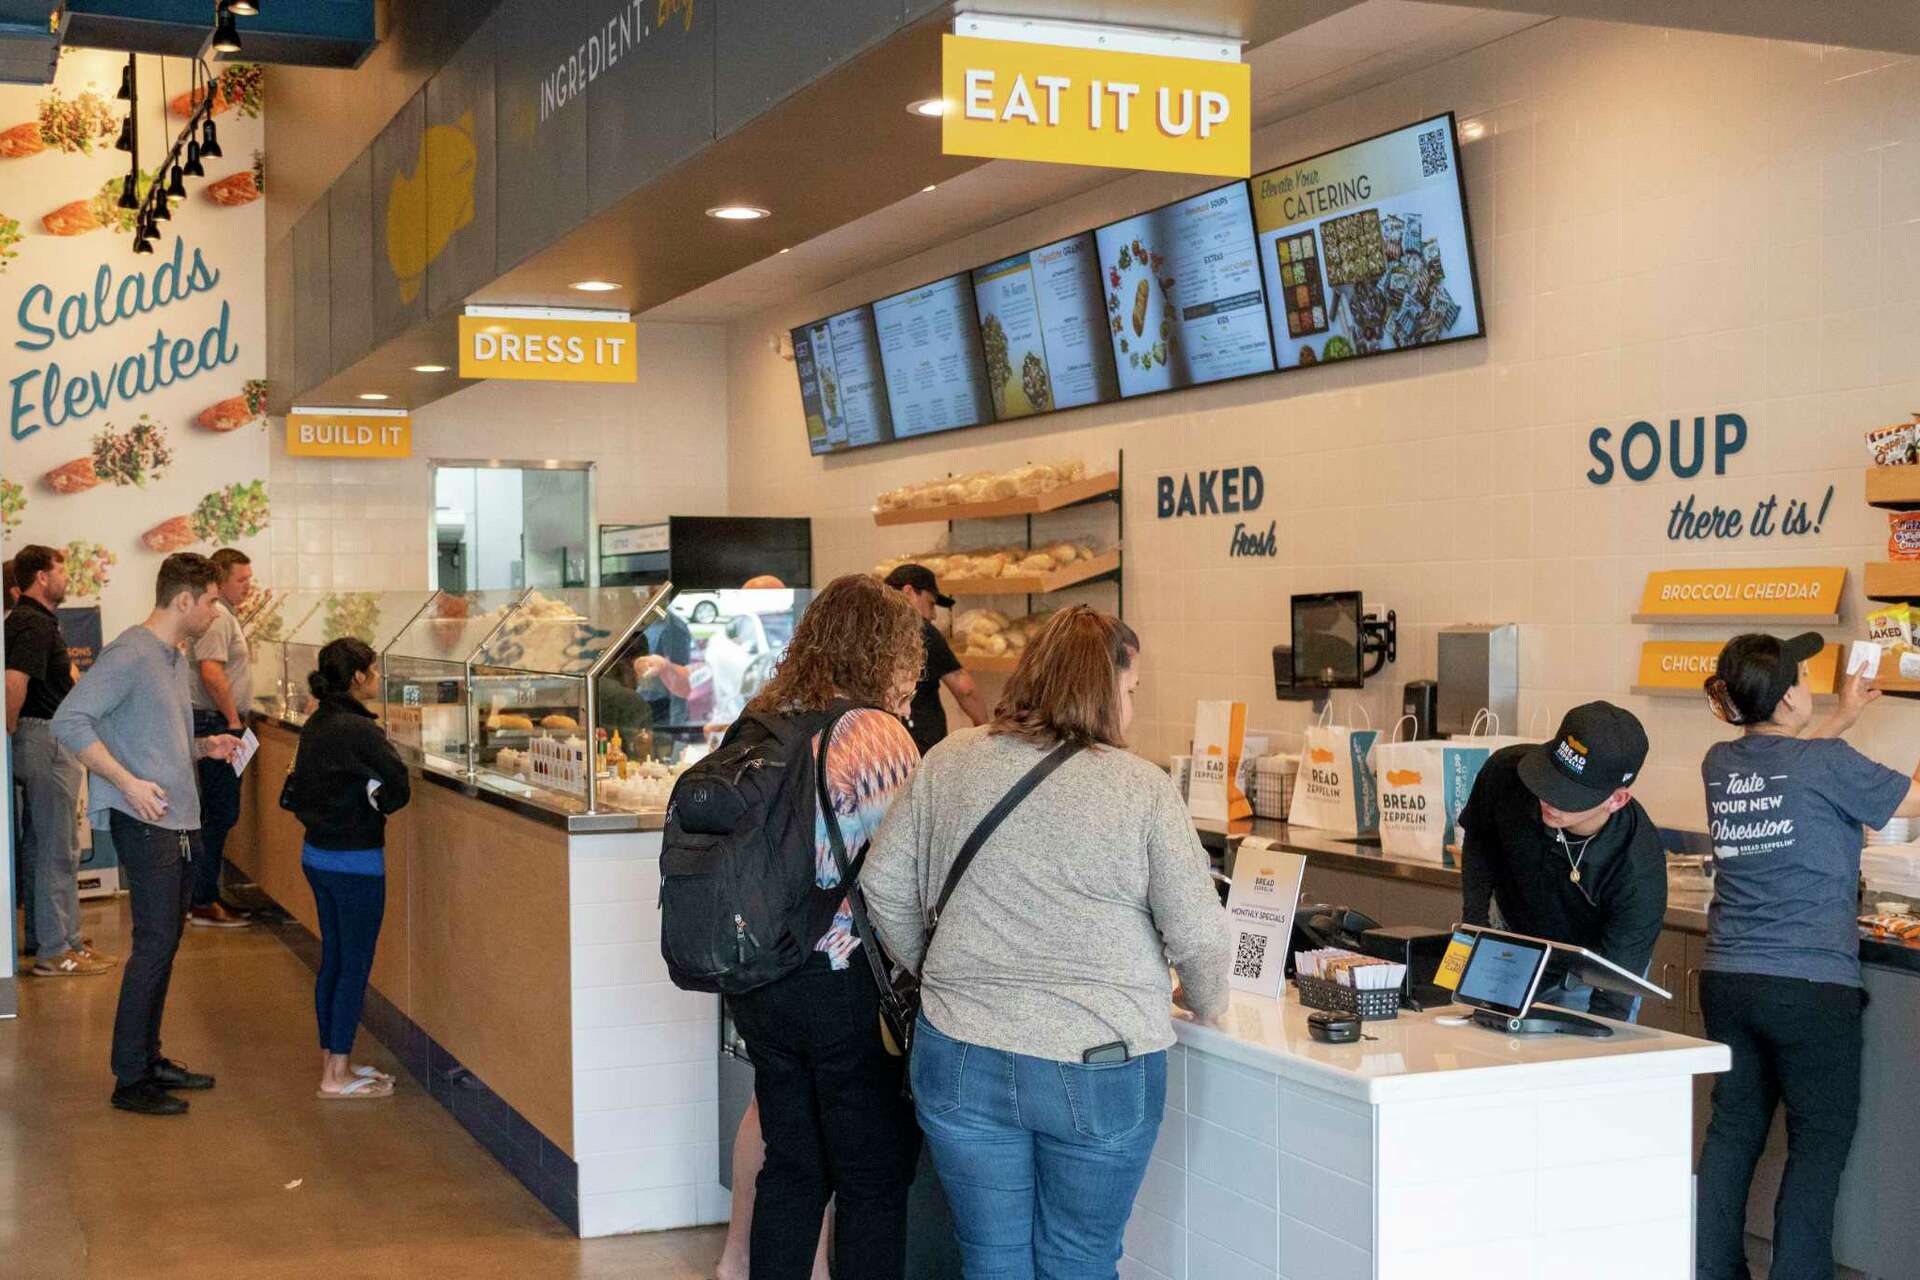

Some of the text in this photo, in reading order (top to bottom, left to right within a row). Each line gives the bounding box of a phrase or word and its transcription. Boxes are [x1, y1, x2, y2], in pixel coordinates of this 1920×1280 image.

[540, 0, 649, 122] INGREDIENT.
[965, 68, 1231, 138] EAT IT UP
[1260, 168, 1320, 200] Elevate Your
[1283, 174, 1372, 221] CATERING
[15, 235, 220, 351] Salads
[474, 332, 626, 366] DRESS IT
[10, 300, 239, 442] Elevated
[299, 423, 403, 446] BUILD IT
[1586, 413, 1748, 485] SOUP
[1157, 465, 1264, 519] BAKED
[1667, 485, 1834, 540] there it is!
[1230, 519, 1277, 558] Fresh
[1660, 581, 1821, 600] BROCCOLI CHEDDAR
[1661, 655, 1718, 672] CHICKE
[1206, 759, 1224, 772] EAD
[1312, 768, 1339, 786] READ
[1306, 783, 1341, 798] ZEPPELIN
[1726, 772, 1766, 795] Taste
[1383, 793, 1426, 811] BREAD
[1711, 795, 1783, 815] YOUR NEW
[1383, 811, 1427, 824] ZEPPELIN
[1711, 819, 1794, 841] Obsession
[1231, 906, 1259, 919] MONTHLY
[1258, 911, 1285, 923] SPECIALS
